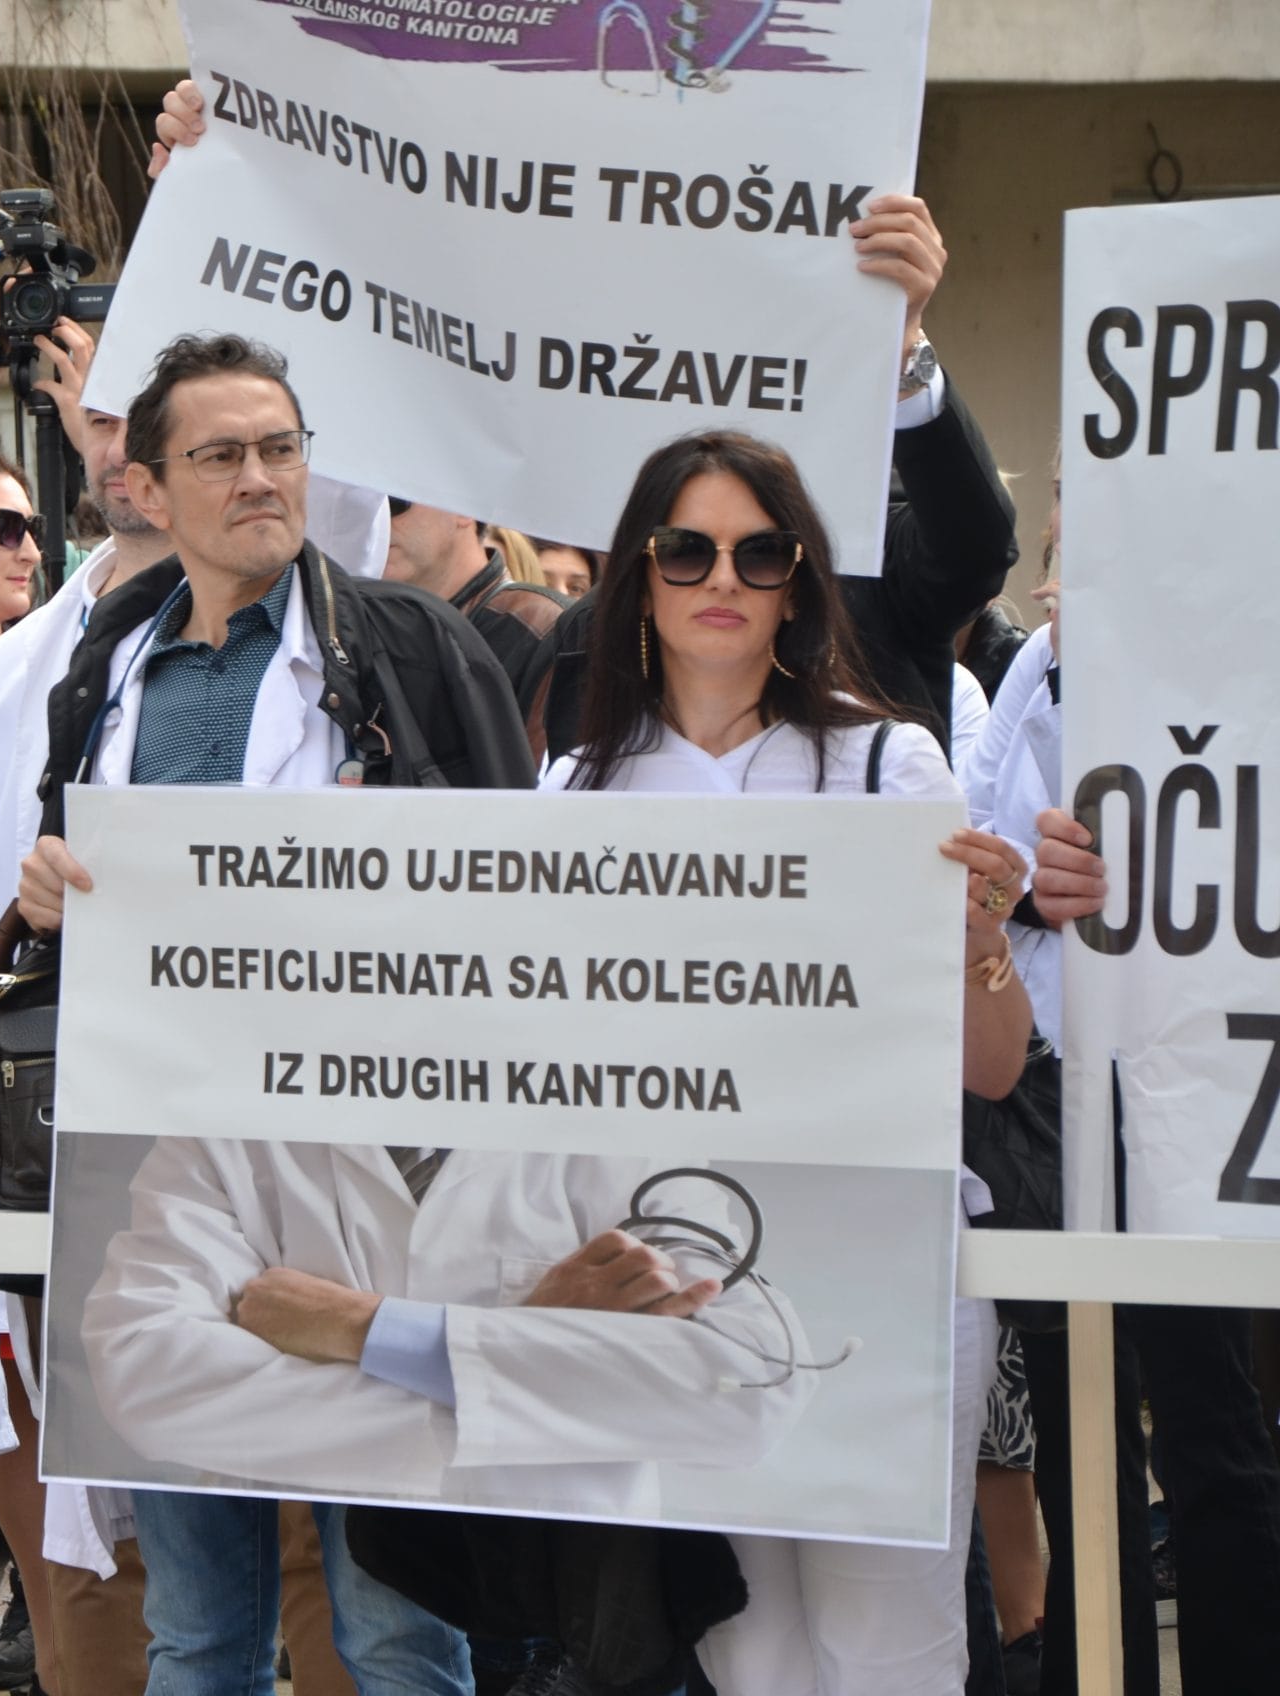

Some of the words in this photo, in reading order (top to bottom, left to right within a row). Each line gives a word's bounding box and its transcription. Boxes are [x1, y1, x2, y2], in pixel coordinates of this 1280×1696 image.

[287, 0, 401, 30] ZLANSKOG
[405, 16, 519, 45] KANTONA
[362, 0, 557, 26] MATOLOGIJE
[210, 71, 428, 195] ZDRAVSTVO
[445, 150, 576, 219] NIJE
[598, 163, 874, 238] TROŠAK
[201, 237, 352, 323] NEGO
[365, 280, 517, 382] TEMELJ
[538, 332, 808, 413] DRŽAVE!
[189, 837, 388, 891] TRAŽIMO
[407, 846, 807, 898] UJEDNAČAVANJE
[151, 945, 492, 997] KOEFICIJENATA
[508, 955, 568, 999] SA
[586, 958, 858, 1008] KOLEGAMA
[263, 1052, 303, 1095] IZ
[320, 1054, 489, 1102] DRUGIH
[507, 1061, 741, 1112] KANTONA
